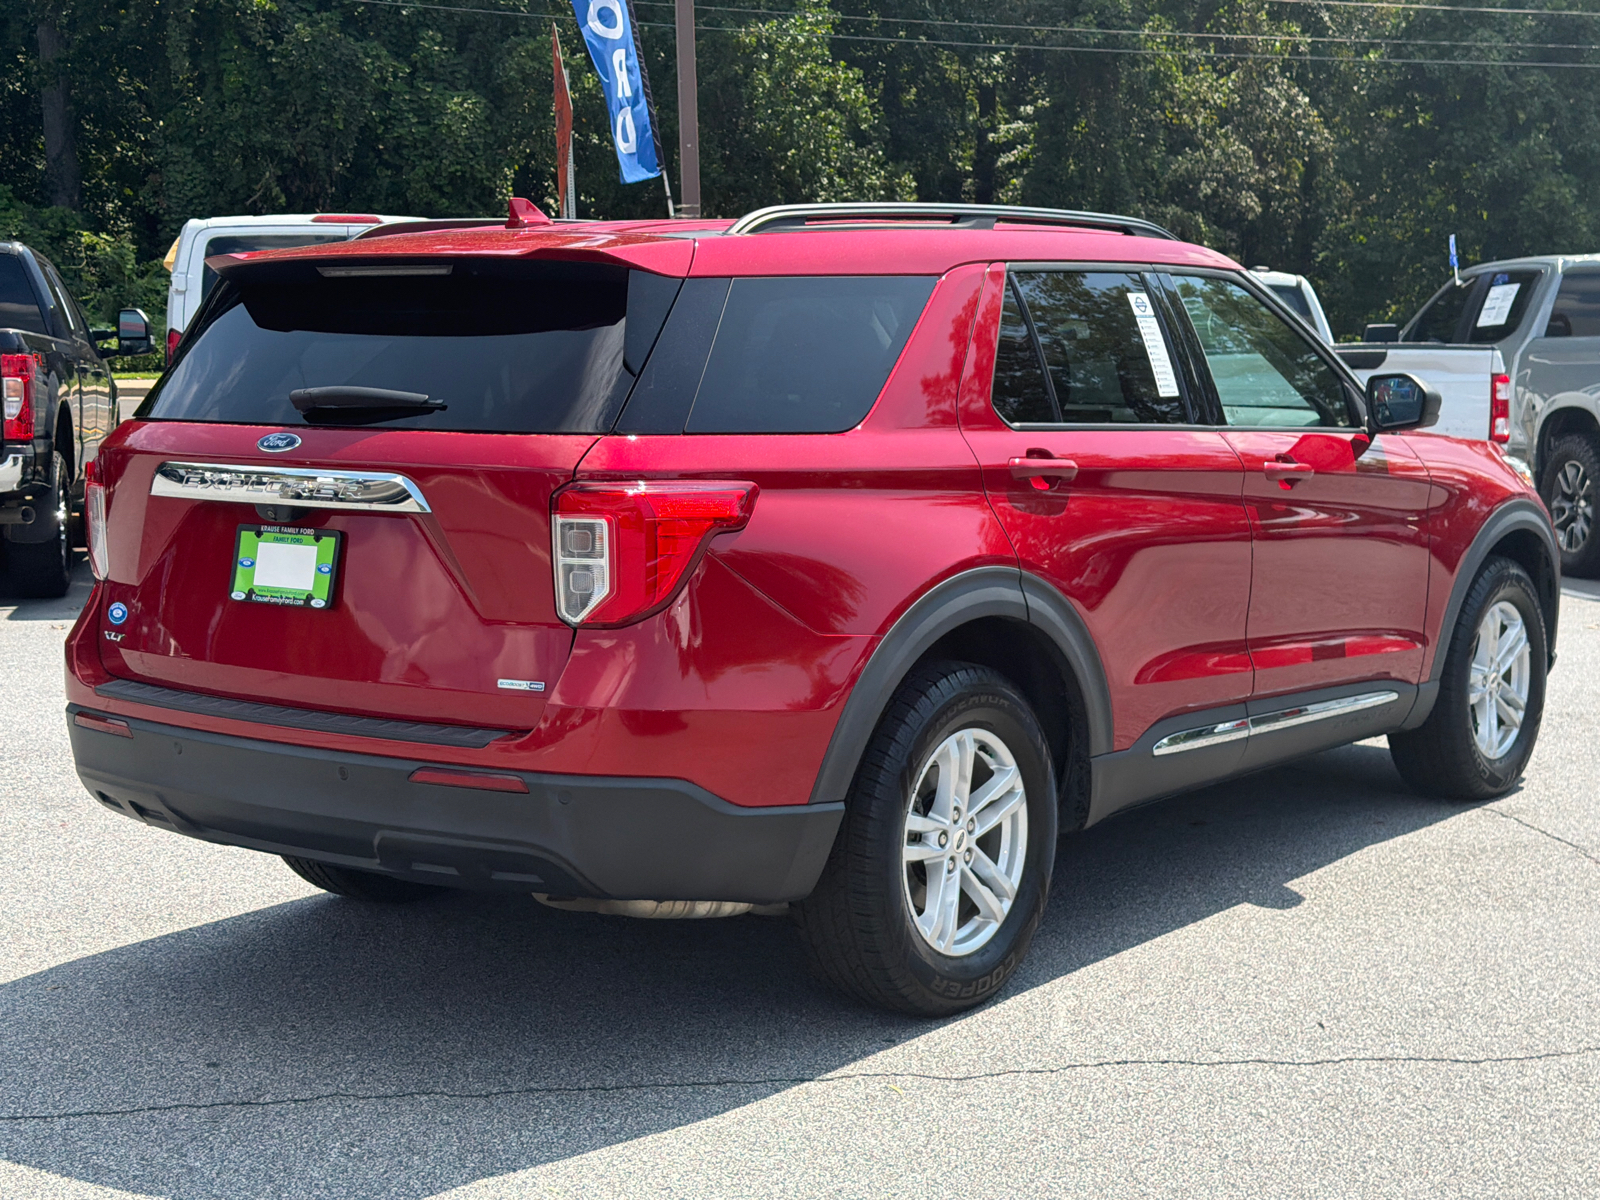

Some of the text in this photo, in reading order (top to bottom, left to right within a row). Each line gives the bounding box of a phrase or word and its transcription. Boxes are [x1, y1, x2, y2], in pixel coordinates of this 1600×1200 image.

[263, 434, 291, 447] Ford
[181, 473, 365, 499] EXPLORER
[260, 525, 315, 536] KRAUSE FAMILY FORD
[930, 950, 1017, 998] COOPER
